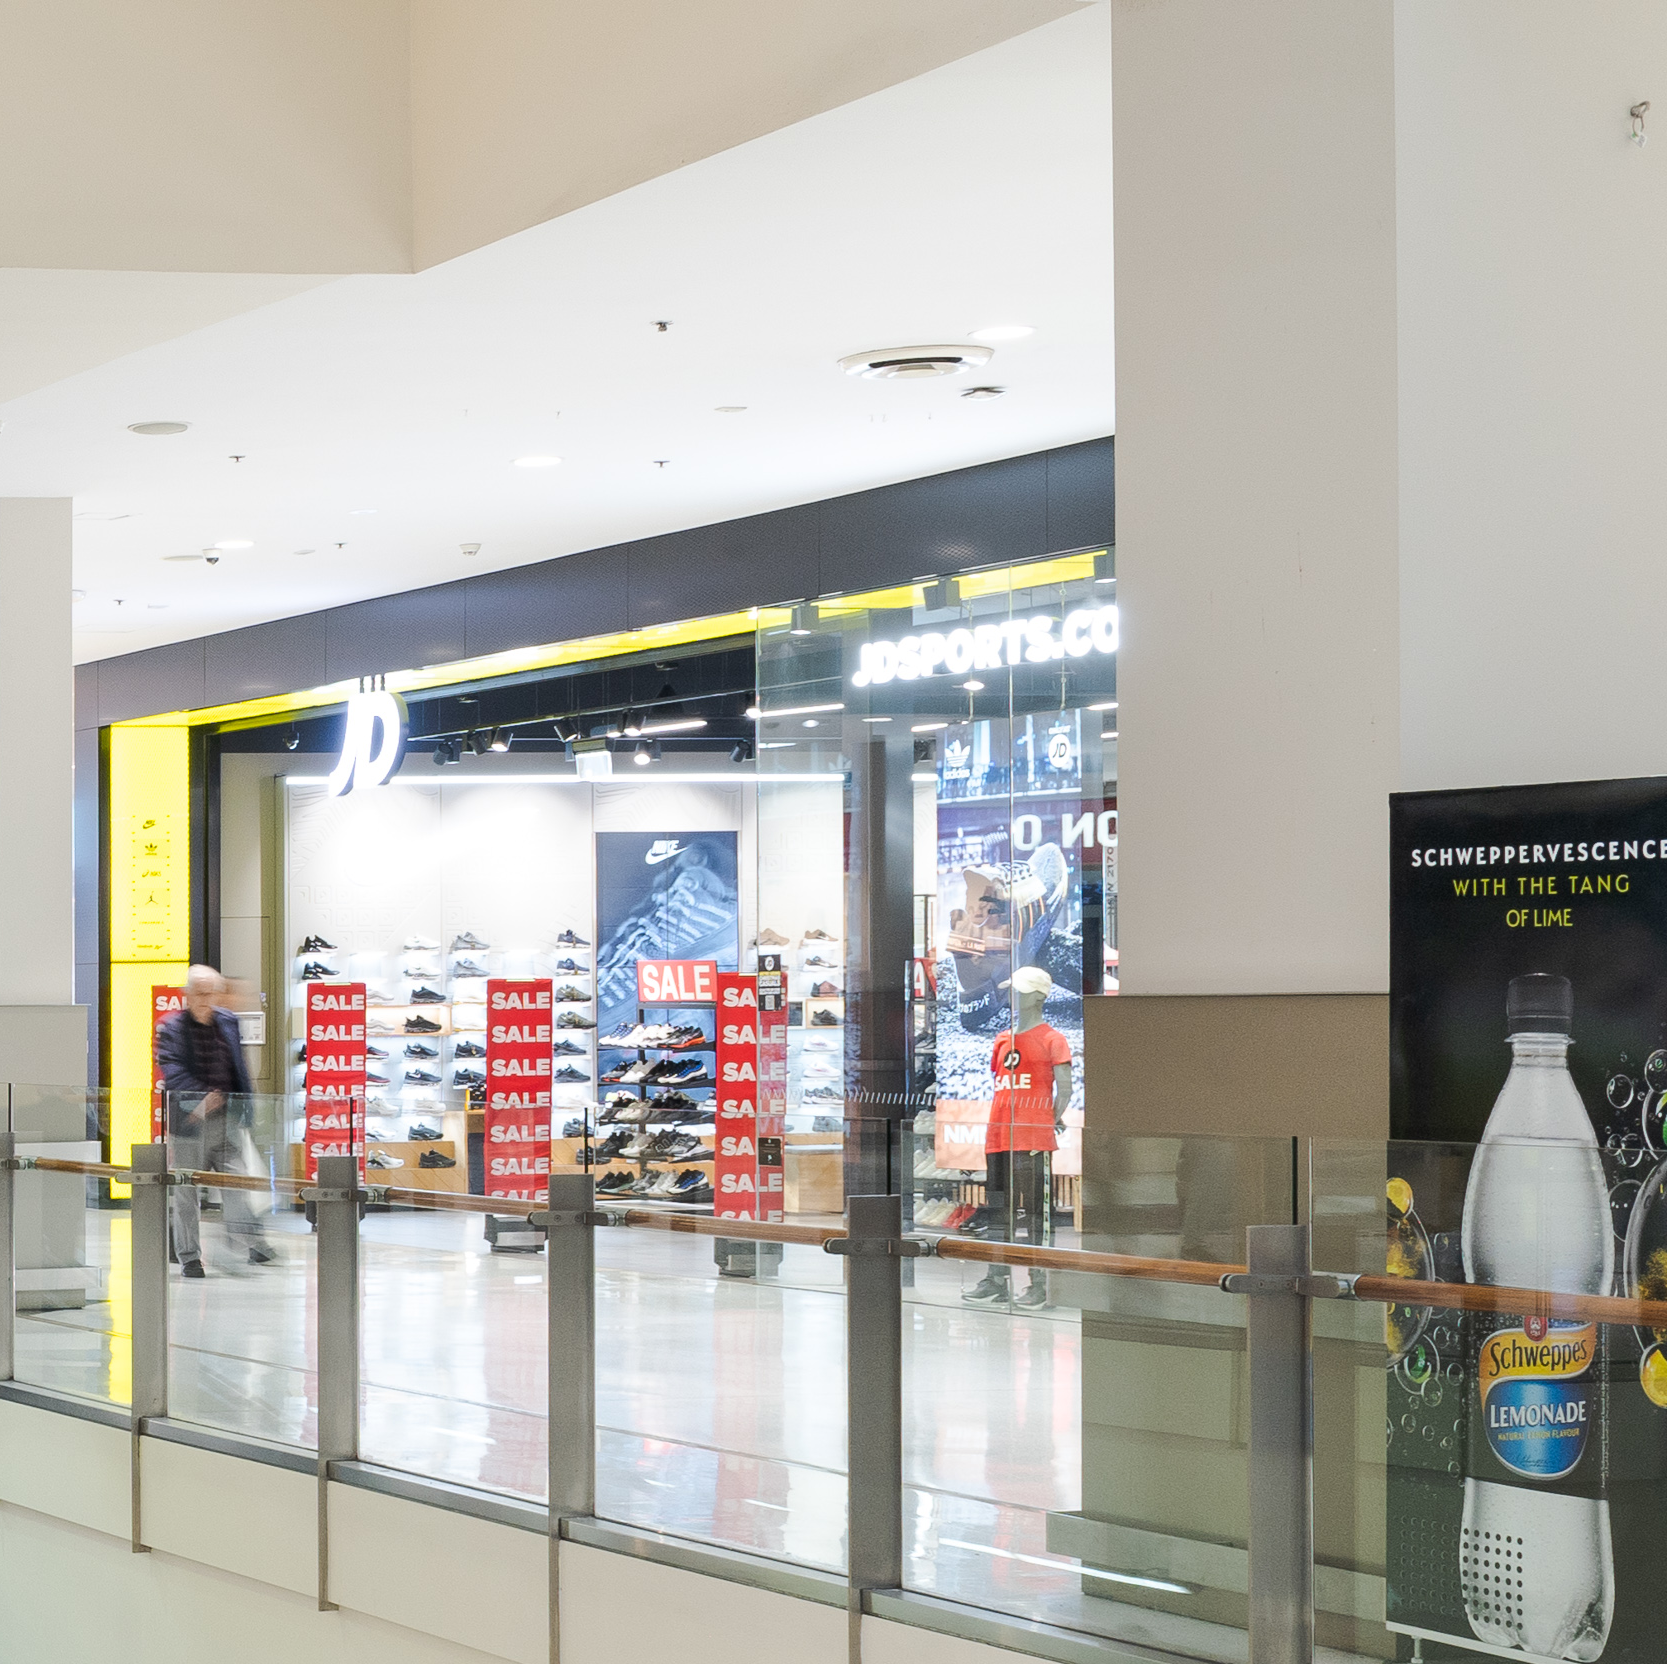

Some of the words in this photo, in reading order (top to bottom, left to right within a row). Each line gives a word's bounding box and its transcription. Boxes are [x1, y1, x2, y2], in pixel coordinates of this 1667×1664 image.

[1052, 742, 1068, 758] JD
[1411, 839, 1667, 867] SCHWEPPERVESCENCE
[1453, 878, 1506, 896] WITH
[1518, 877, 1557, 895] THE
[1568, 874, 1630, 894] TANG
[1506, 909, 1529, 928] OF
[1533, 908, 1573, 927] LIME
[642, 964, 713, 1000] SALE
[310, 995, 364, 1011] SALE
[491, 992, 550, 1010] SALE
[723, 987, 786, 1007] SAE
[310, 1025, 364, 1041] SALE
[491, 1025, 550, 1043] SALE
[723, 1024, 786, 1044] SALE
[310, 1055, 364, 1071] SALE
[491, 1058, 550, 1076] SALE
[722, 1062, 786, 1082] SALE
[994, 1074, 1031, 1091] SALE
[310, 1085, 364, 1101] SALE
[490, 1092, 550, 1110] SALE
[720, 1099, 784, 1119] SALE
[490, 1125, 549, 1143] SALE
[490, 1158, 549, 1176] SALE
[720, 1173, 783, 1193] SALE
[1488, 1338, 1587, 1377] Schweppes
[1490, 1400, 1587, 1428] LEMONADE
